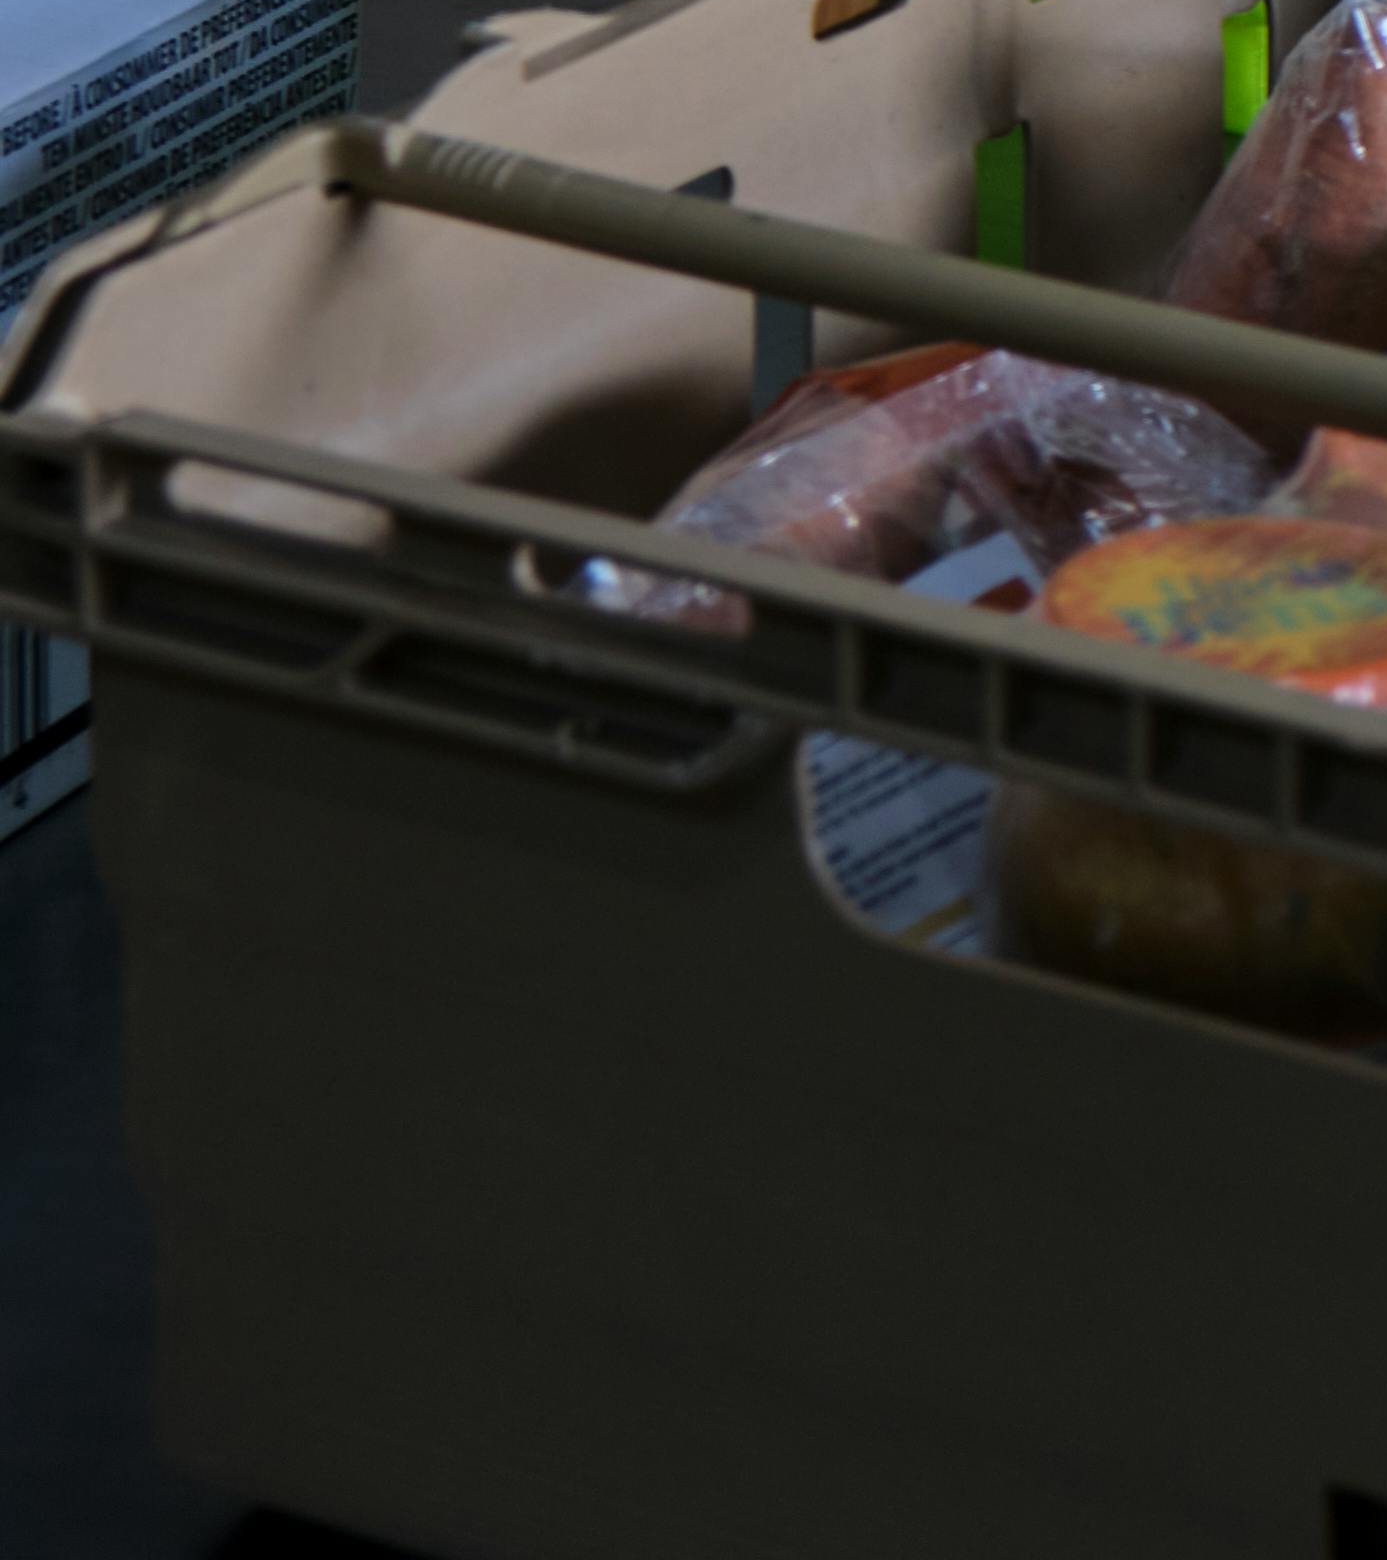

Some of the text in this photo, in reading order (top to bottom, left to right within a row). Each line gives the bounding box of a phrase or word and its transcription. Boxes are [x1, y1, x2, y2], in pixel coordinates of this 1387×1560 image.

[2, 98, 59, 156] BEFORE
[86, 35, 176, 111] CONSOMMER
[181, 24, 197, 60] DE
[131, 55, 209, 124] HOUDBAAR
[213, 41, 237, 80] TOT
[250, 25, 266, 60] DA
[151, 84, 224, 151] CONSUMIR
[2, 219, 48, 272] ANTES
[91, 153, 167, 221] CONSUMIR
[171, 141, 187, 176] DE
[285, 63, 326, 112] ANTES
[329, 52, 347, 87] DE
